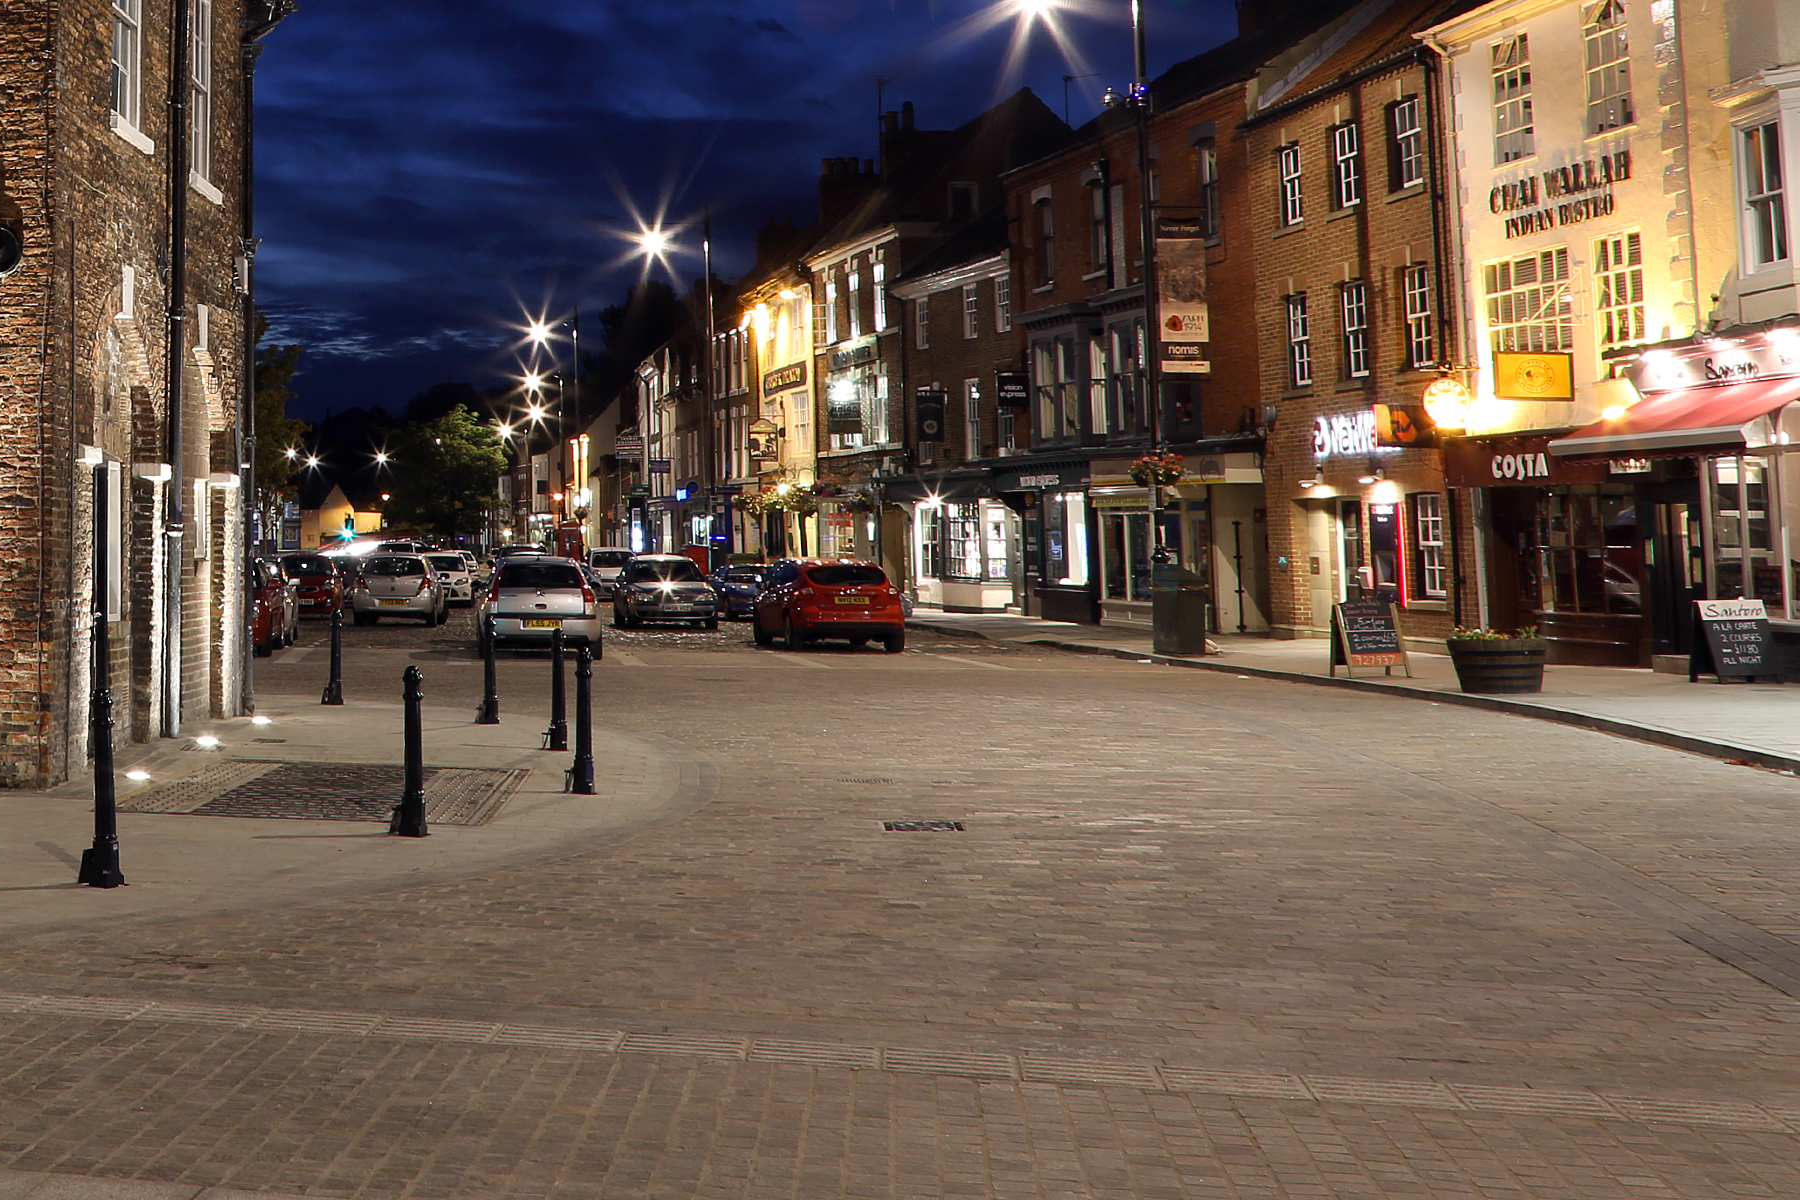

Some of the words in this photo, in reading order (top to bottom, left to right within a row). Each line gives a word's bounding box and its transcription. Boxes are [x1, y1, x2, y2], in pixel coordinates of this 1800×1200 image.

[1489, 176, 1539, 214] CHAI
[1542, 150, 1632, 198] WALLAH
[1505, 208, 1554, 239] INDIAN
[1559, 194, 1614, 226] BISTRO
[1168, 346, 1199, 355] nomis
[1492, 453, 1548, 481] COSTA
[1704, 604, 1762, 617] Santoro
[1735, 622, 1758, 630] CARTE
[1721, 634, 1728, 642] 2
[1729, 633, 1762, 642] COURSES
